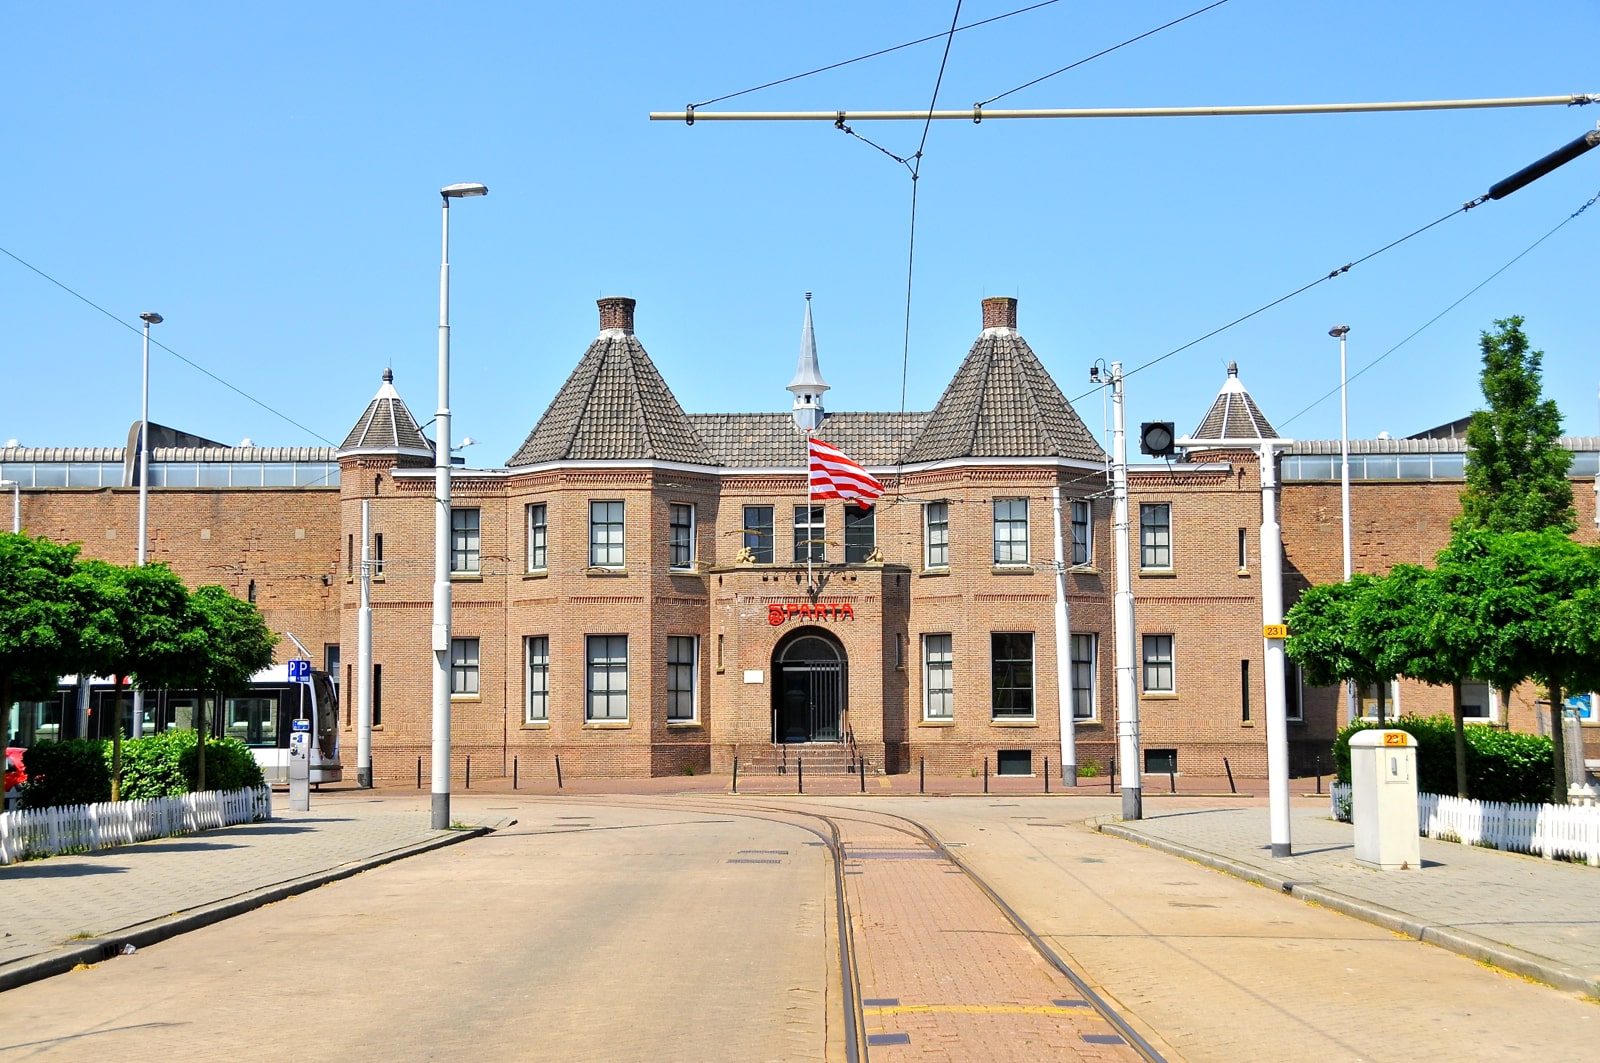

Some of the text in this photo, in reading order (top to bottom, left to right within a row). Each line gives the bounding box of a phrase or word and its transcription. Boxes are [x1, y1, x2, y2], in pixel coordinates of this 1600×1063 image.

[768, 603, 854, 626] SPARTA
[1267, 627, 1283, 635] 231
[290, 661, 296, 676] P
[300, 661, 308, 676] P
